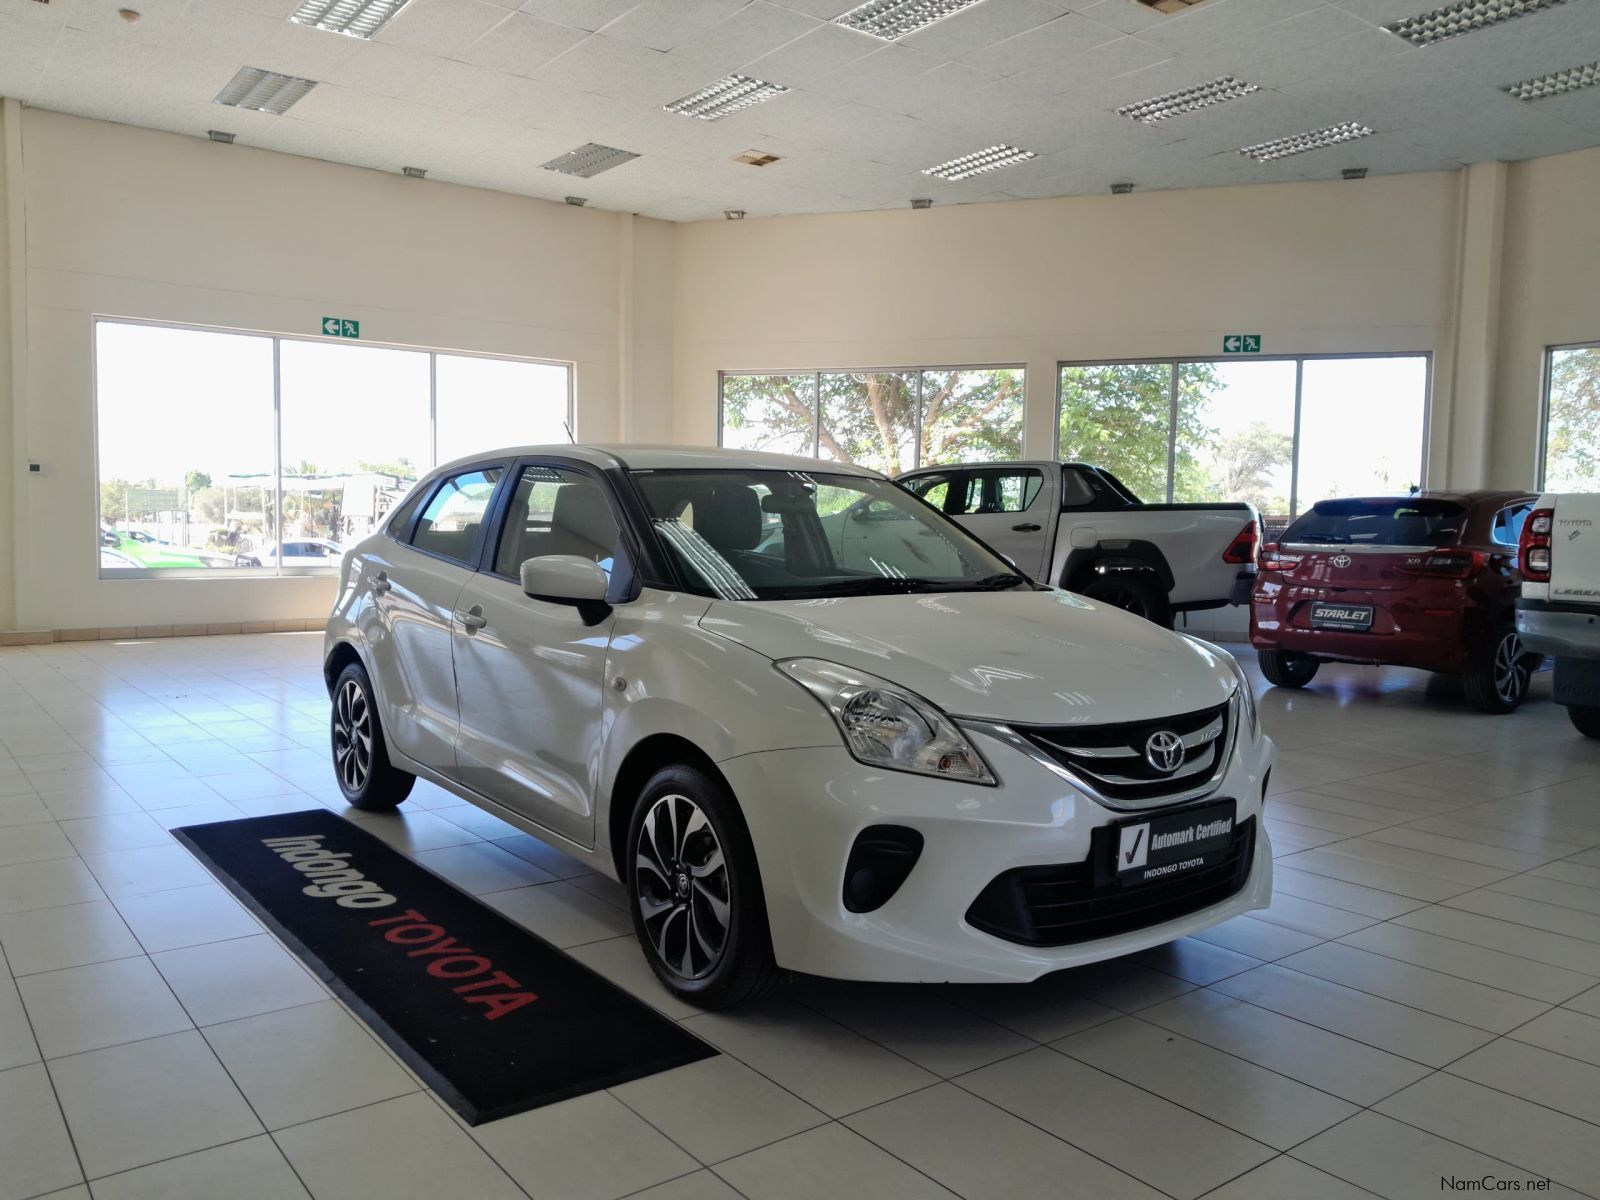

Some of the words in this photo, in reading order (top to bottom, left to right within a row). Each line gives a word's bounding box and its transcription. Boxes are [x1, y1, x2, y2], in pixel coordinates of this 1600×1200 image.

[1314, 608, 1369, 620] STARLET
[1151, 826, 1194, 851] Automark
[1196, 817, 1232, 841] Certified
[1144, 863, 1178, 879] INDONGO
[1179, 857, 1204, 871] TOYOTA
[261, 834, 398, 909] Indongo
[368, 909, 539, 1021] TOYOTA
